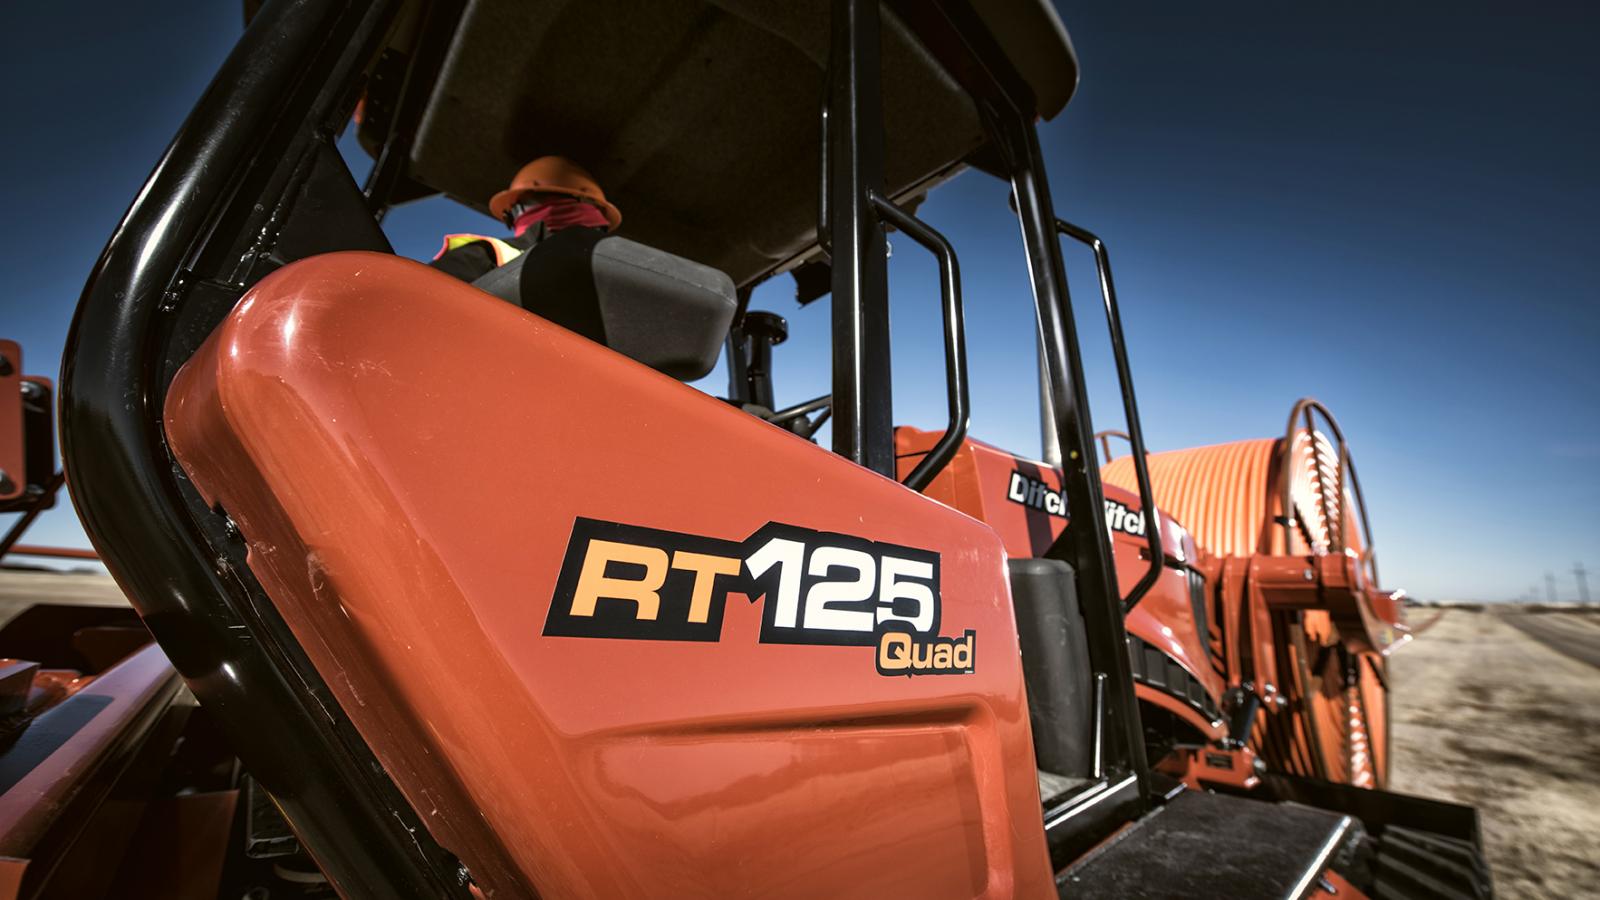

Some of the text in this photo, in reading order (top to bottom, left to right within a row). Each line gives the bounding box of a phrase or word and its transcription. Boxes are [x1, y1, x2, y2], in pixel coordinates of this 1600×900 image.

[1103, 500, 1147, 536] itc
[569, 537, 935, 632] RT125
[879, 631, 973, 670] Quad
